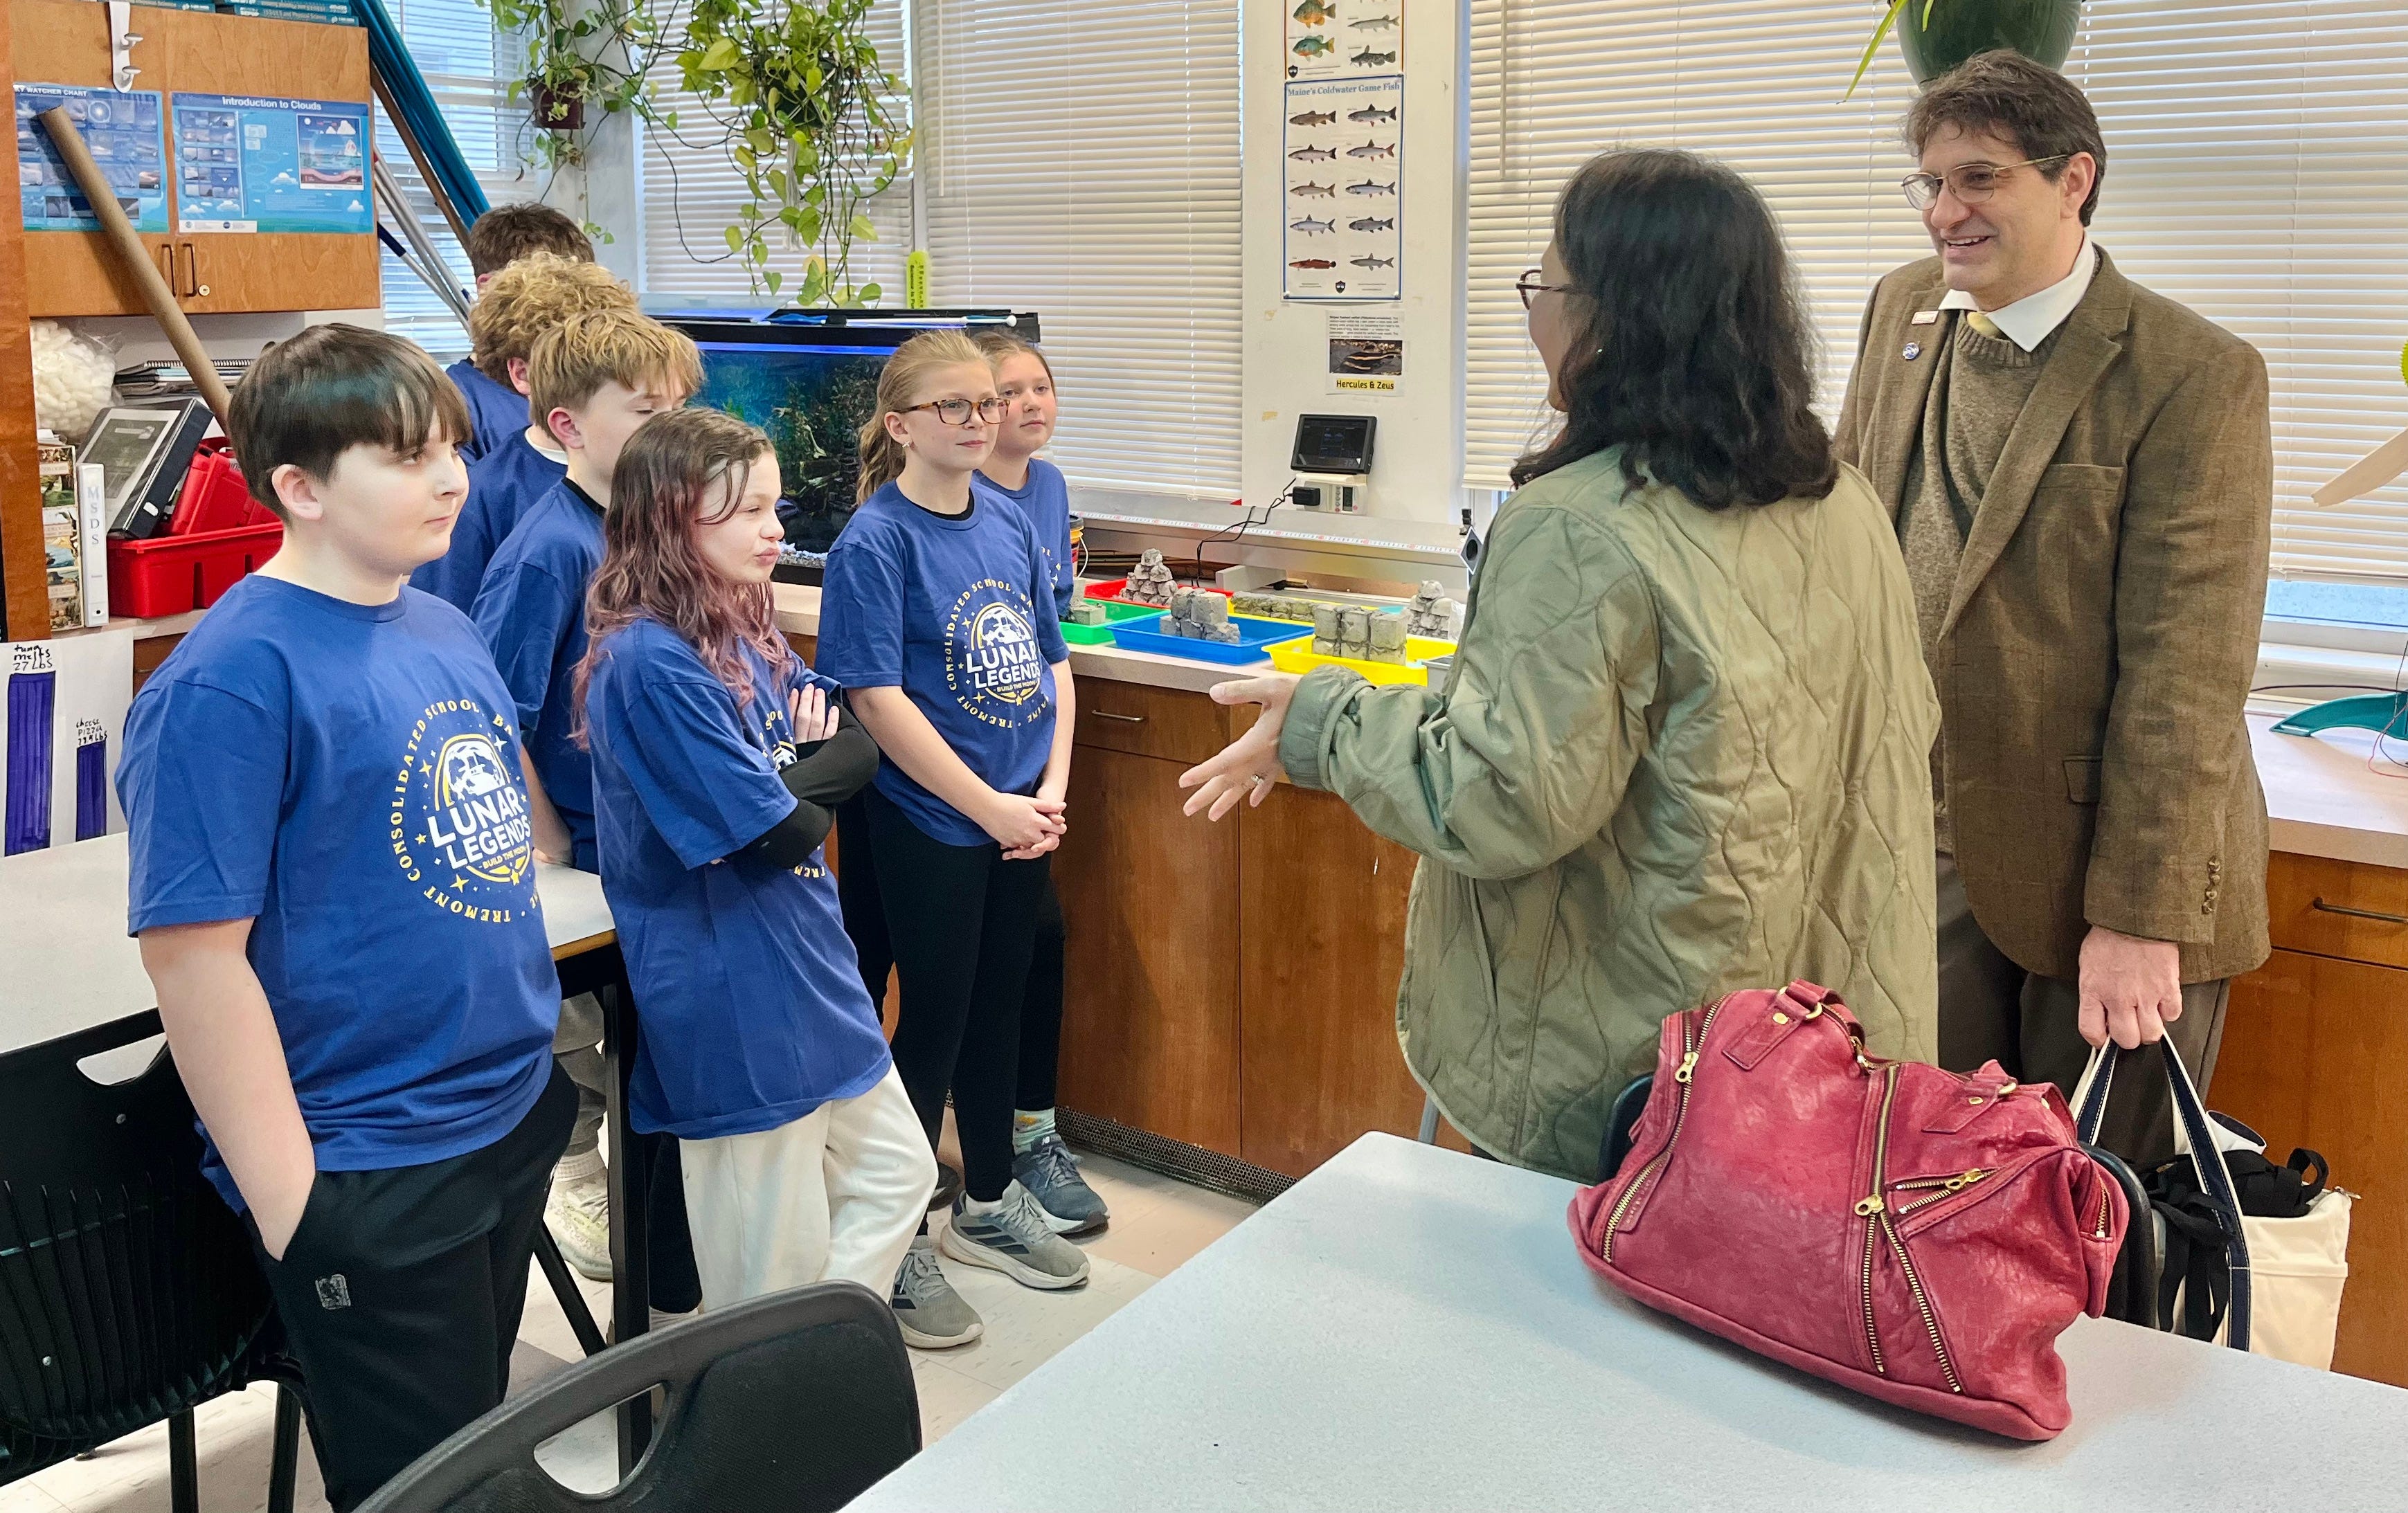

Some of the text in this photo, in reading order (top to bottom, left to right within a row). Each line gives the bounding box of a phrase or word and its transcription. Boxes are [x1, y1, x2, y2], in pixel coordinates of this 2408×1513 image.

[26, 87, 62, 96] WATCHER
[63, 89, 87, 97] CHART
[1288, 82, 1401, 97] Maine's Coldwater Game Fish
[222, 96, 322, 111] Introduction to Clouds
[1336, 379, 1394, 390] Hercules & Zeus
[87, 486, 100, 545] MSDS
[971, 578, 1011, 592] SCHOOL
[15, 644, 41, 652] tuna
[944, 590, 971, 691] CONSOLIDATED
[12, 661, 29, 671] 27
[966, 641, 1038, 673] LUNAR
[424, 698, 480, 720] SCHOOL
[957, 695, 1013, 729] TREMONT
[1027, 696, 1049, 723] AINE
[390, 718, 427, 882] CONSOLIDATED
[427, 786, 525, 848] LUNAR
[446, 815, 532, 870] LEGENDS
[482, 855, 503, 869] BUILD
[423, 885, 512, 923] TREMONT
